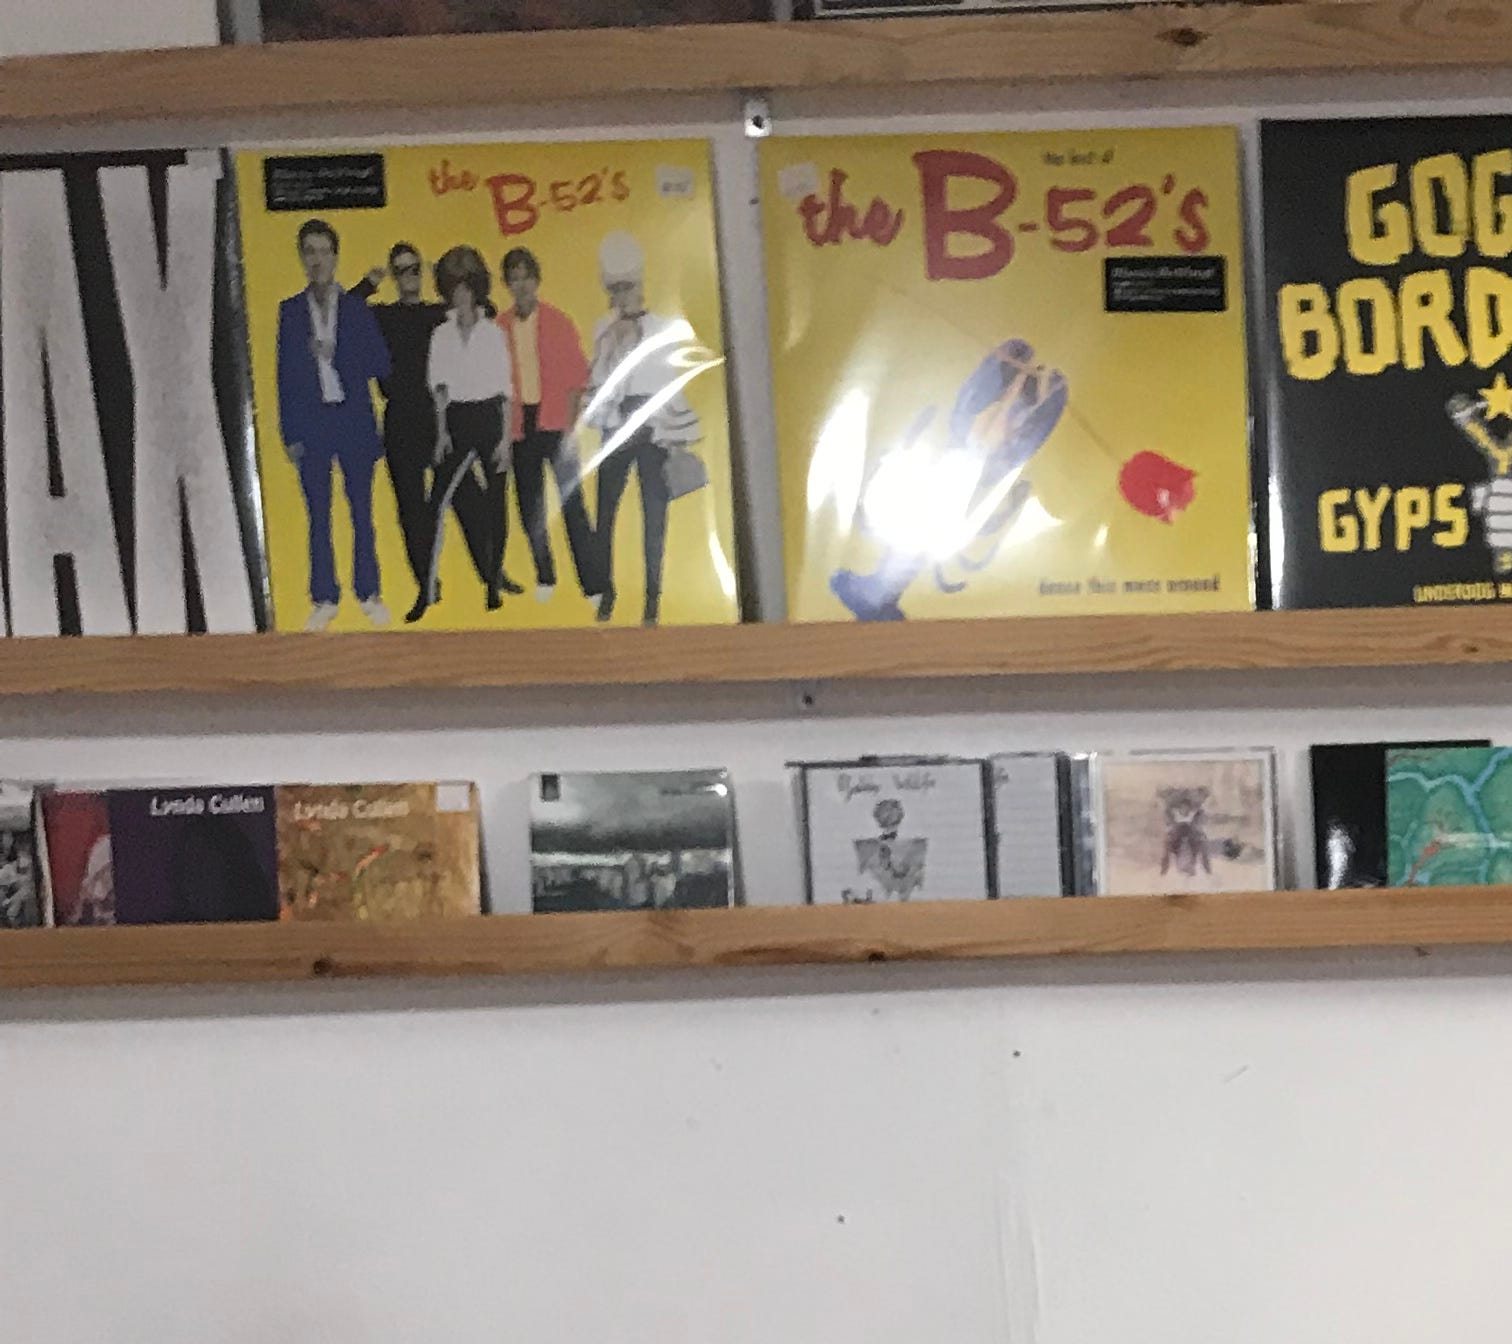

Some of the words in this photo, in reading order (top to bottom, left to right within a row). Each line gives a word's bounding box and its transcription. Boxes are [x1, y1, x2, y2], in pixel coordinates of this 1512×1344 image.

[430, 159, 478, 196] the
[486, 167, 630, 235] B-52's
[798, 167, 904, 246] the
[912, 149, 1211, 281] B-52's
